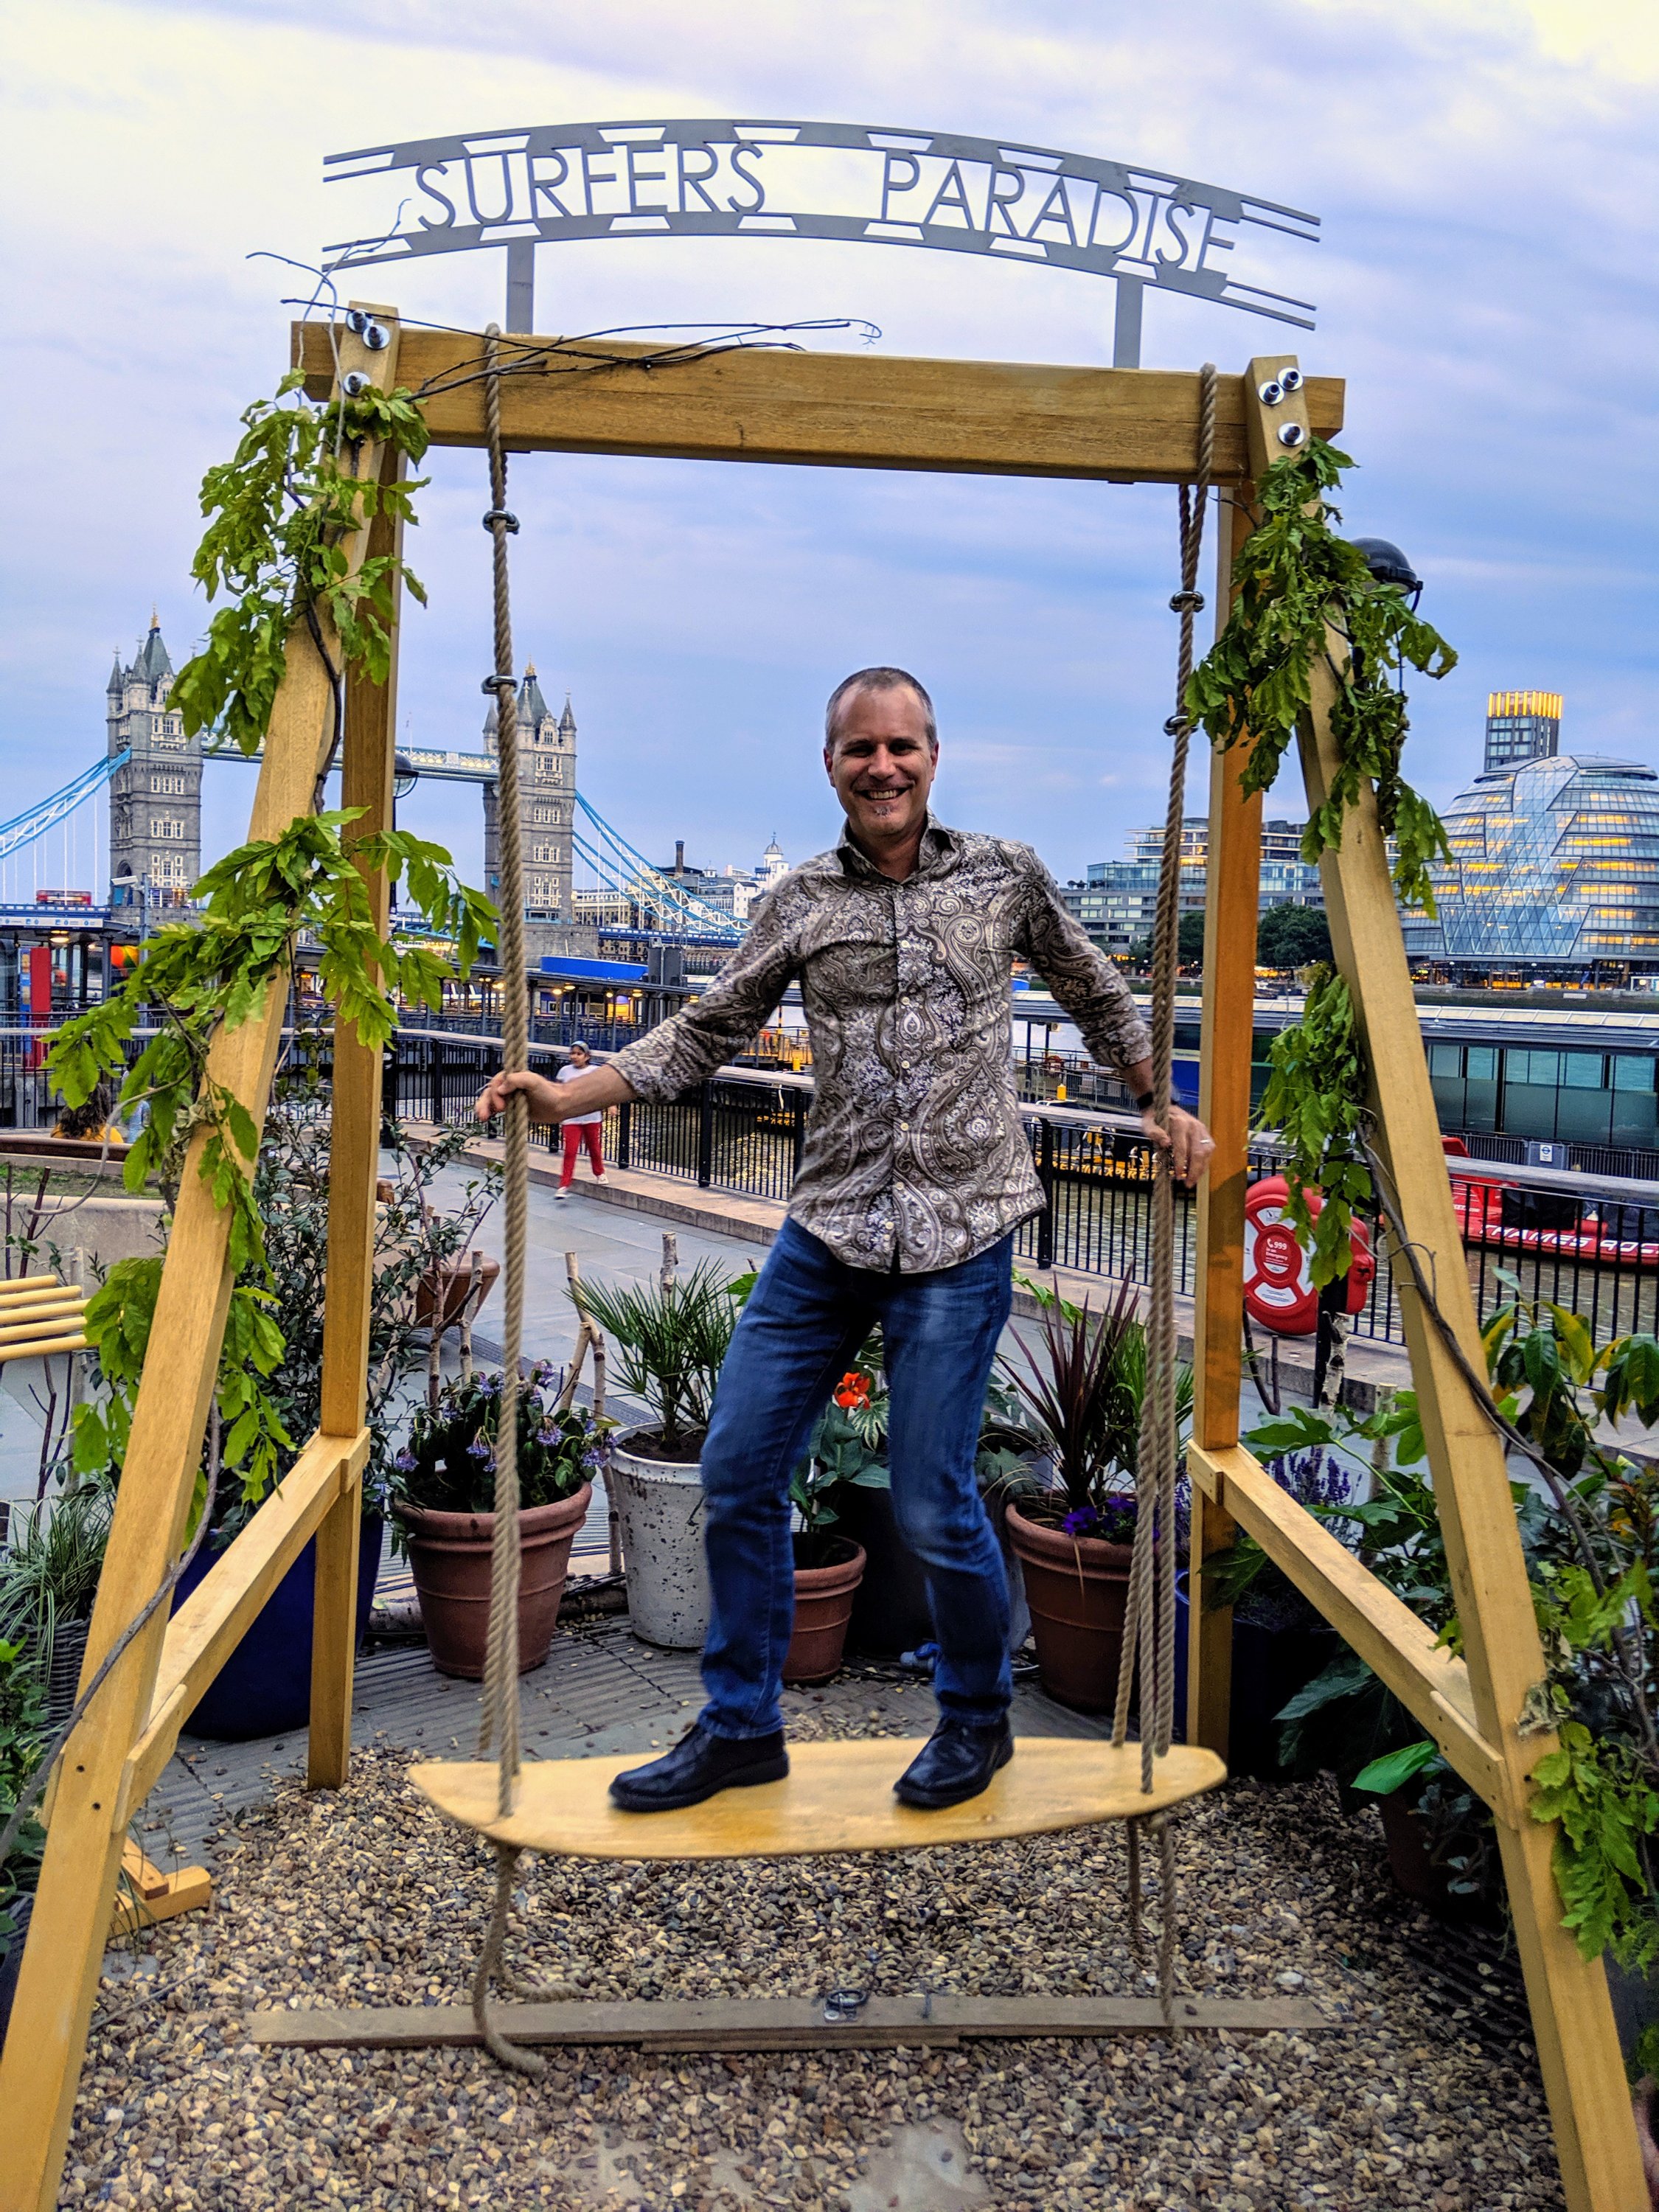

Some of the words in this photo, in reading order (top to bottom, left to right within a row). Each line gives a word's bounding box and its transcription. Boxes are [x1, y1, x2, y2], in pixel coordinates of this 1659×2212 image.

[416, 141, 765, 229] SURFERS
[881, 150, 1240, 281] PARADISE
[1273, 1241, 1287, 1251] 999
[1479, 1224, 1593, 1248] THAMES
